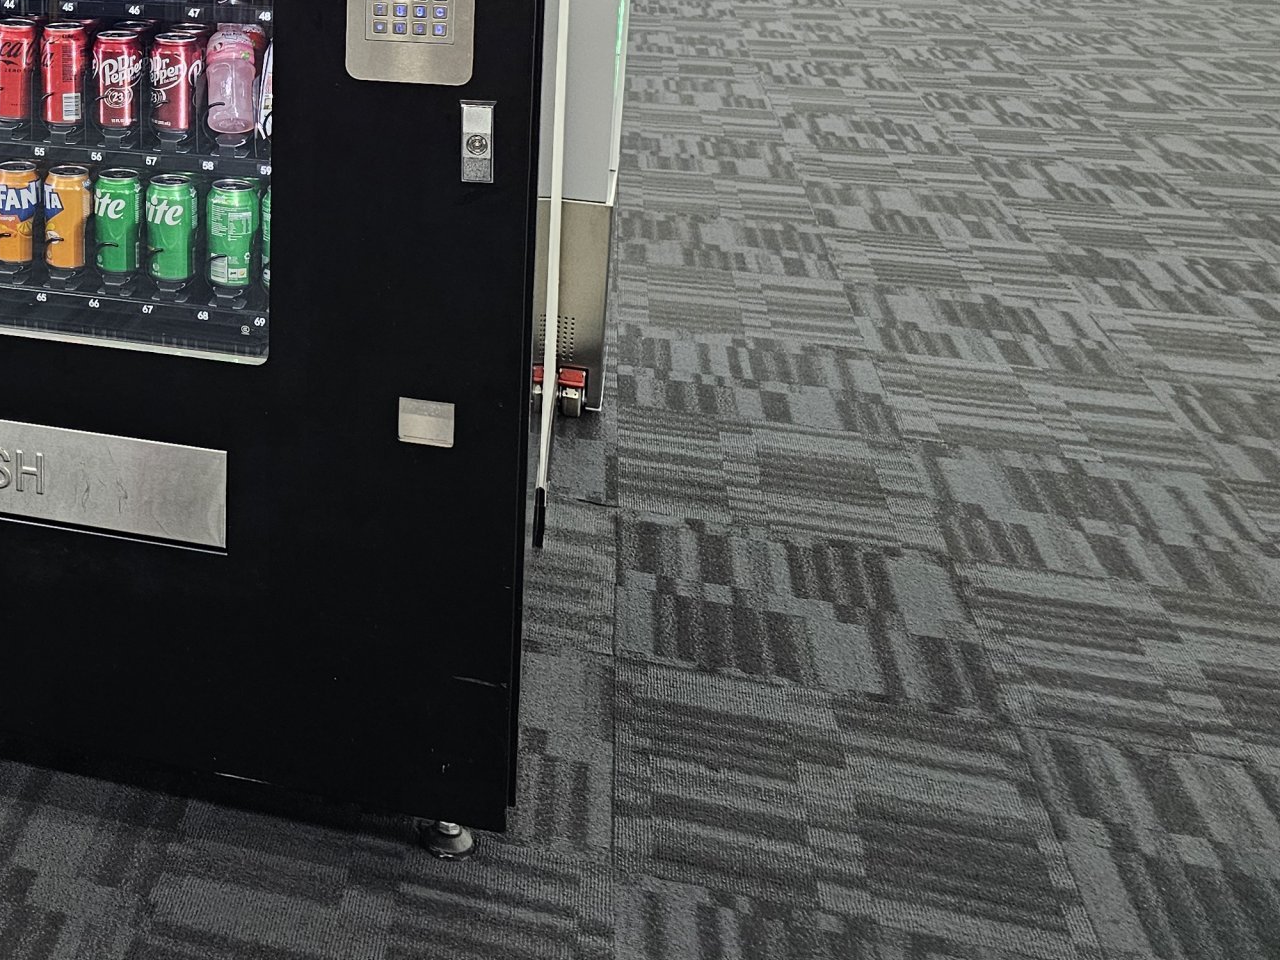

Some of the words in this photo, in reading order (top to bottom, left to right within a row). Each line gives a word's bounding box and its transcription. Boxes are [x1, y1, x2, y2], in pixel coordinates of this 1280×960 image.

[3, 0, 16, 9] 44
[62, 2, 75, 12] 45
[128, 5, 141, 15] 46
[187, 8, 201, 17] 47
[258, 10, 271, 20] 48
[116, 53, 137, 72] Dr
[102, 58, 143, 87] Pepper
[112, 91, 124, 103] 23
[34, 146, 45, 156] 55
[91, 151, 103, 161] 56
[145, 156, 157, 166] 57
[202, 161, 214, 171] 58
[260, 165, 272, 175] 59
[36, 293, 47, 302] 65
[88, 299, 100, 309] 66
[142, 305, 154, 314] 67
[197, 311, 209, 321] 68
[254, 317, 266, 327] 69
